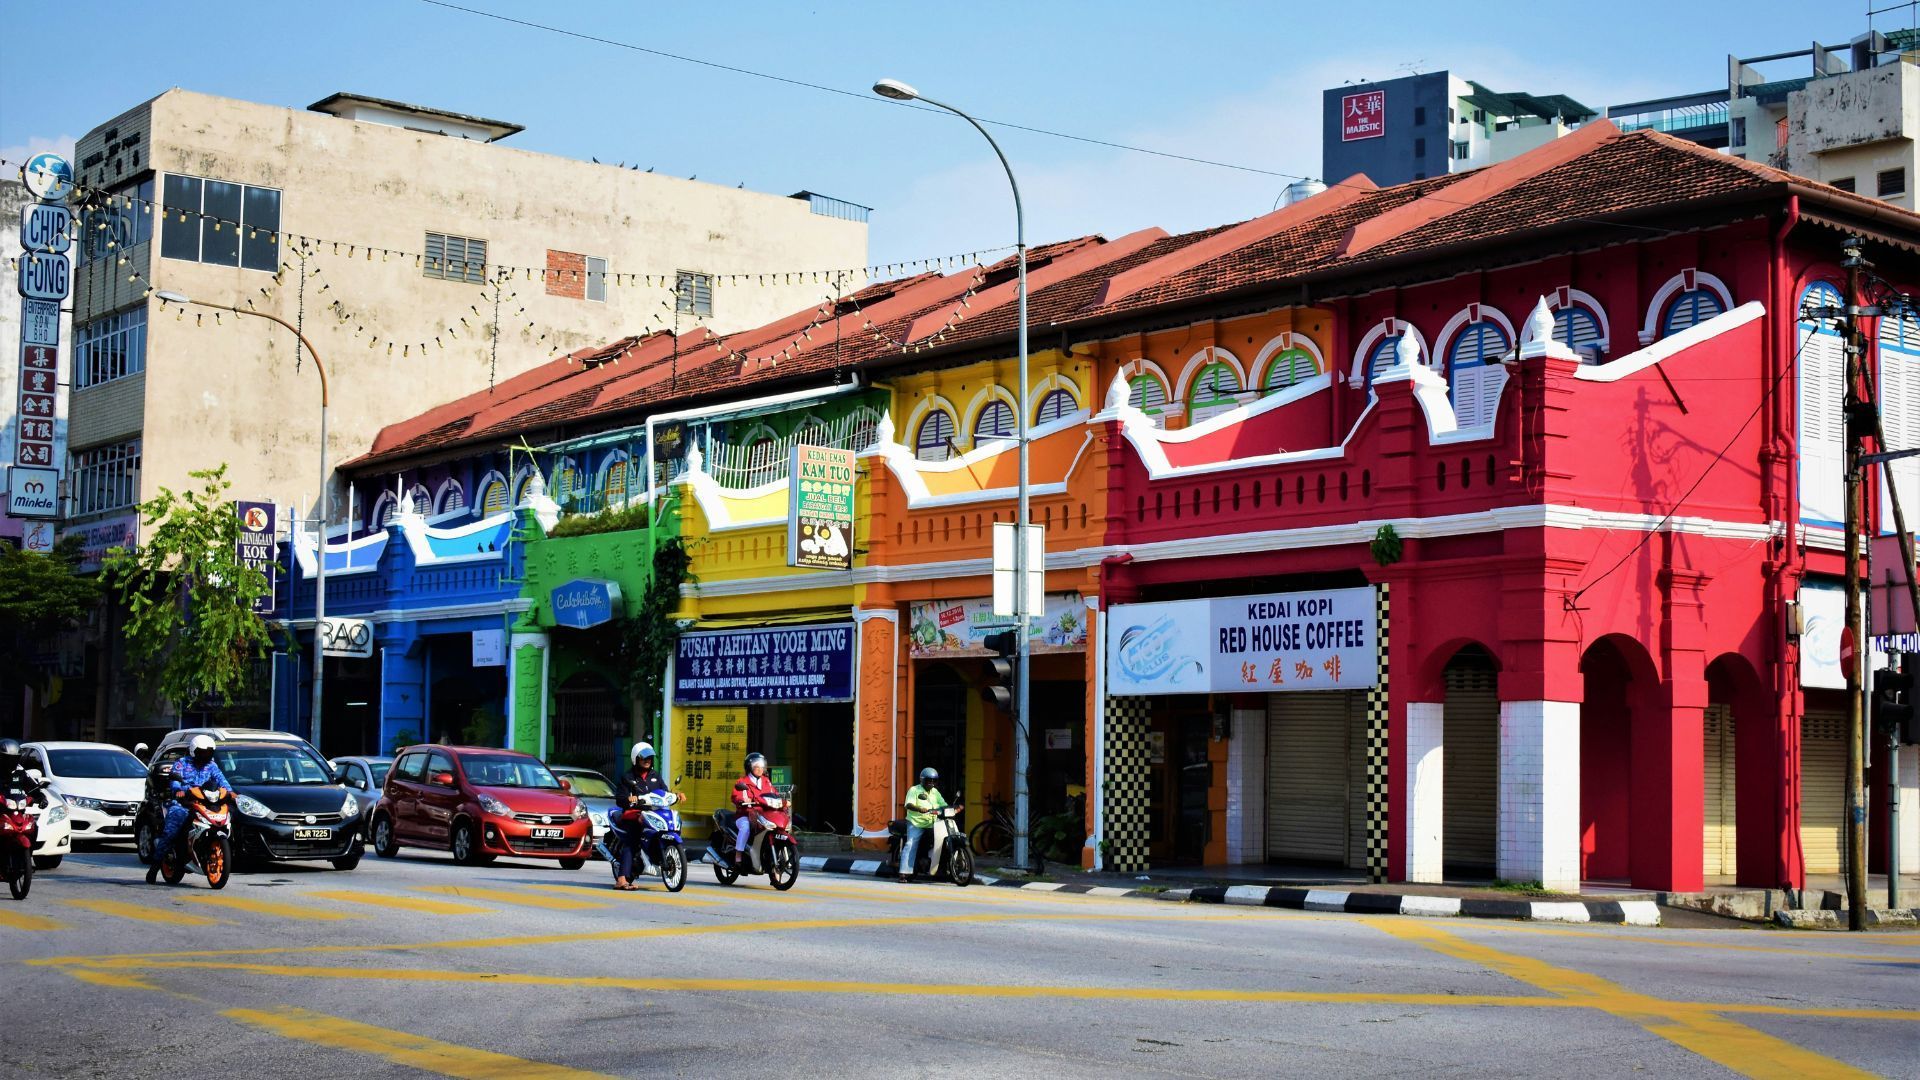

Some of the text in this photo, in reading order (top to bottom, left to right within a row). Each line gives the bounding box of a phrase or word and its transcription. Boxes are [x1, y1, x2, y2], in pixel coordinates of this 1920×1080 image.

[1346, 96, 1381, 118] 大華
[1346, 122, 1380, 134] MAJESTIC
[30, 208, 65, 246] CHIP
[26, 256, 65, 294] FONG
[28, 300, 57, 317] ENTERPRISE
[34, 316, 48, 329] SDN
[34, 328, 48, 342] BHD
[32, 348, 49, 368] 集
[24, 397, 51, 414] 企業
[24, 421, 52, 438] 有限
[20, 446, 49, 463] 公司
[808, 450, 846, 464] KEDAI EMAS
[802, 462, 850, 482] KAM TUO
[806, 493, 846, 504] JUAL BELI
[248, 510, 262, 527] K
[244, 545, 268, 558] KOK
[1248, 598, 1333, 620] KEDAI KOPI
[680, 629, 846, 658] PUSAT JAHITAN YOOH MING
[1220, 620, 1364, 654] RED HOUSE COFFEE
[1241, 654, 1342, 684] 紅屋咖啡
[687, 713, 704, 732] 車字
[312, 830, 328, 838] 7225
